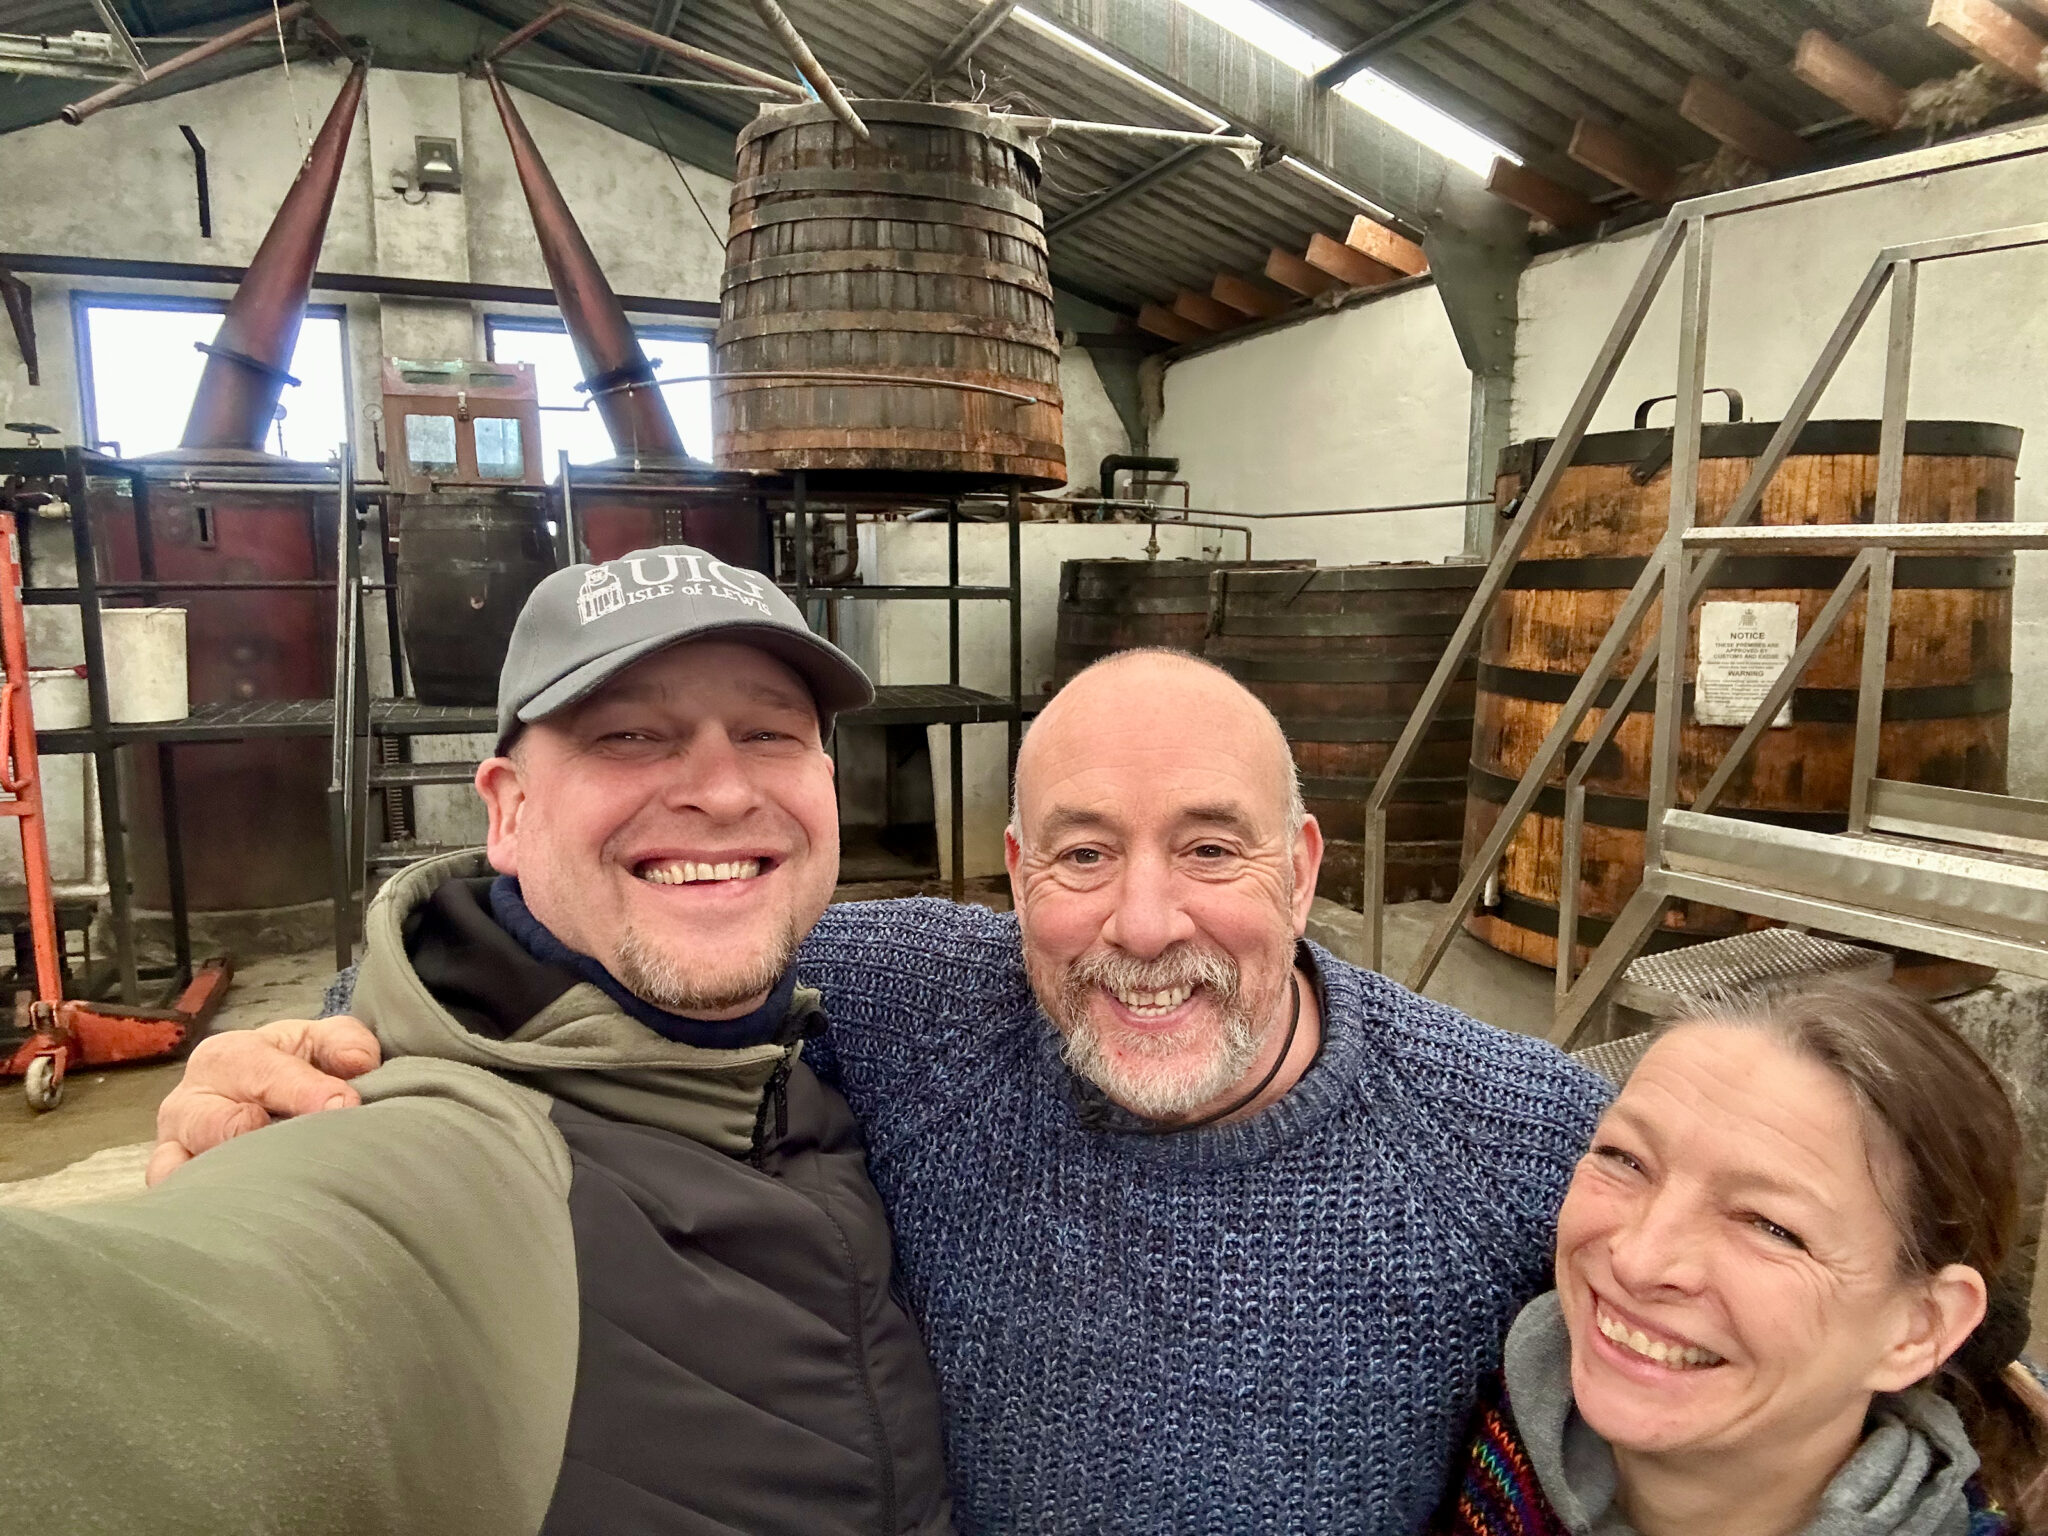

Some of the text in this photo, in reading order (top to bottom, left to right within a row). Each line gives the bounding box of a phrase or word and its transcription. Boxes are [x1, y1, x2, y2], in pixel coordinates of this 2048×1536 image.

[624, 554, 763, 600] UIG
[626, 584, 674, 605] ISLE
[711, 585, 772, 616] LEWIS
[1730, 632, 1766, 640] NOTICE
